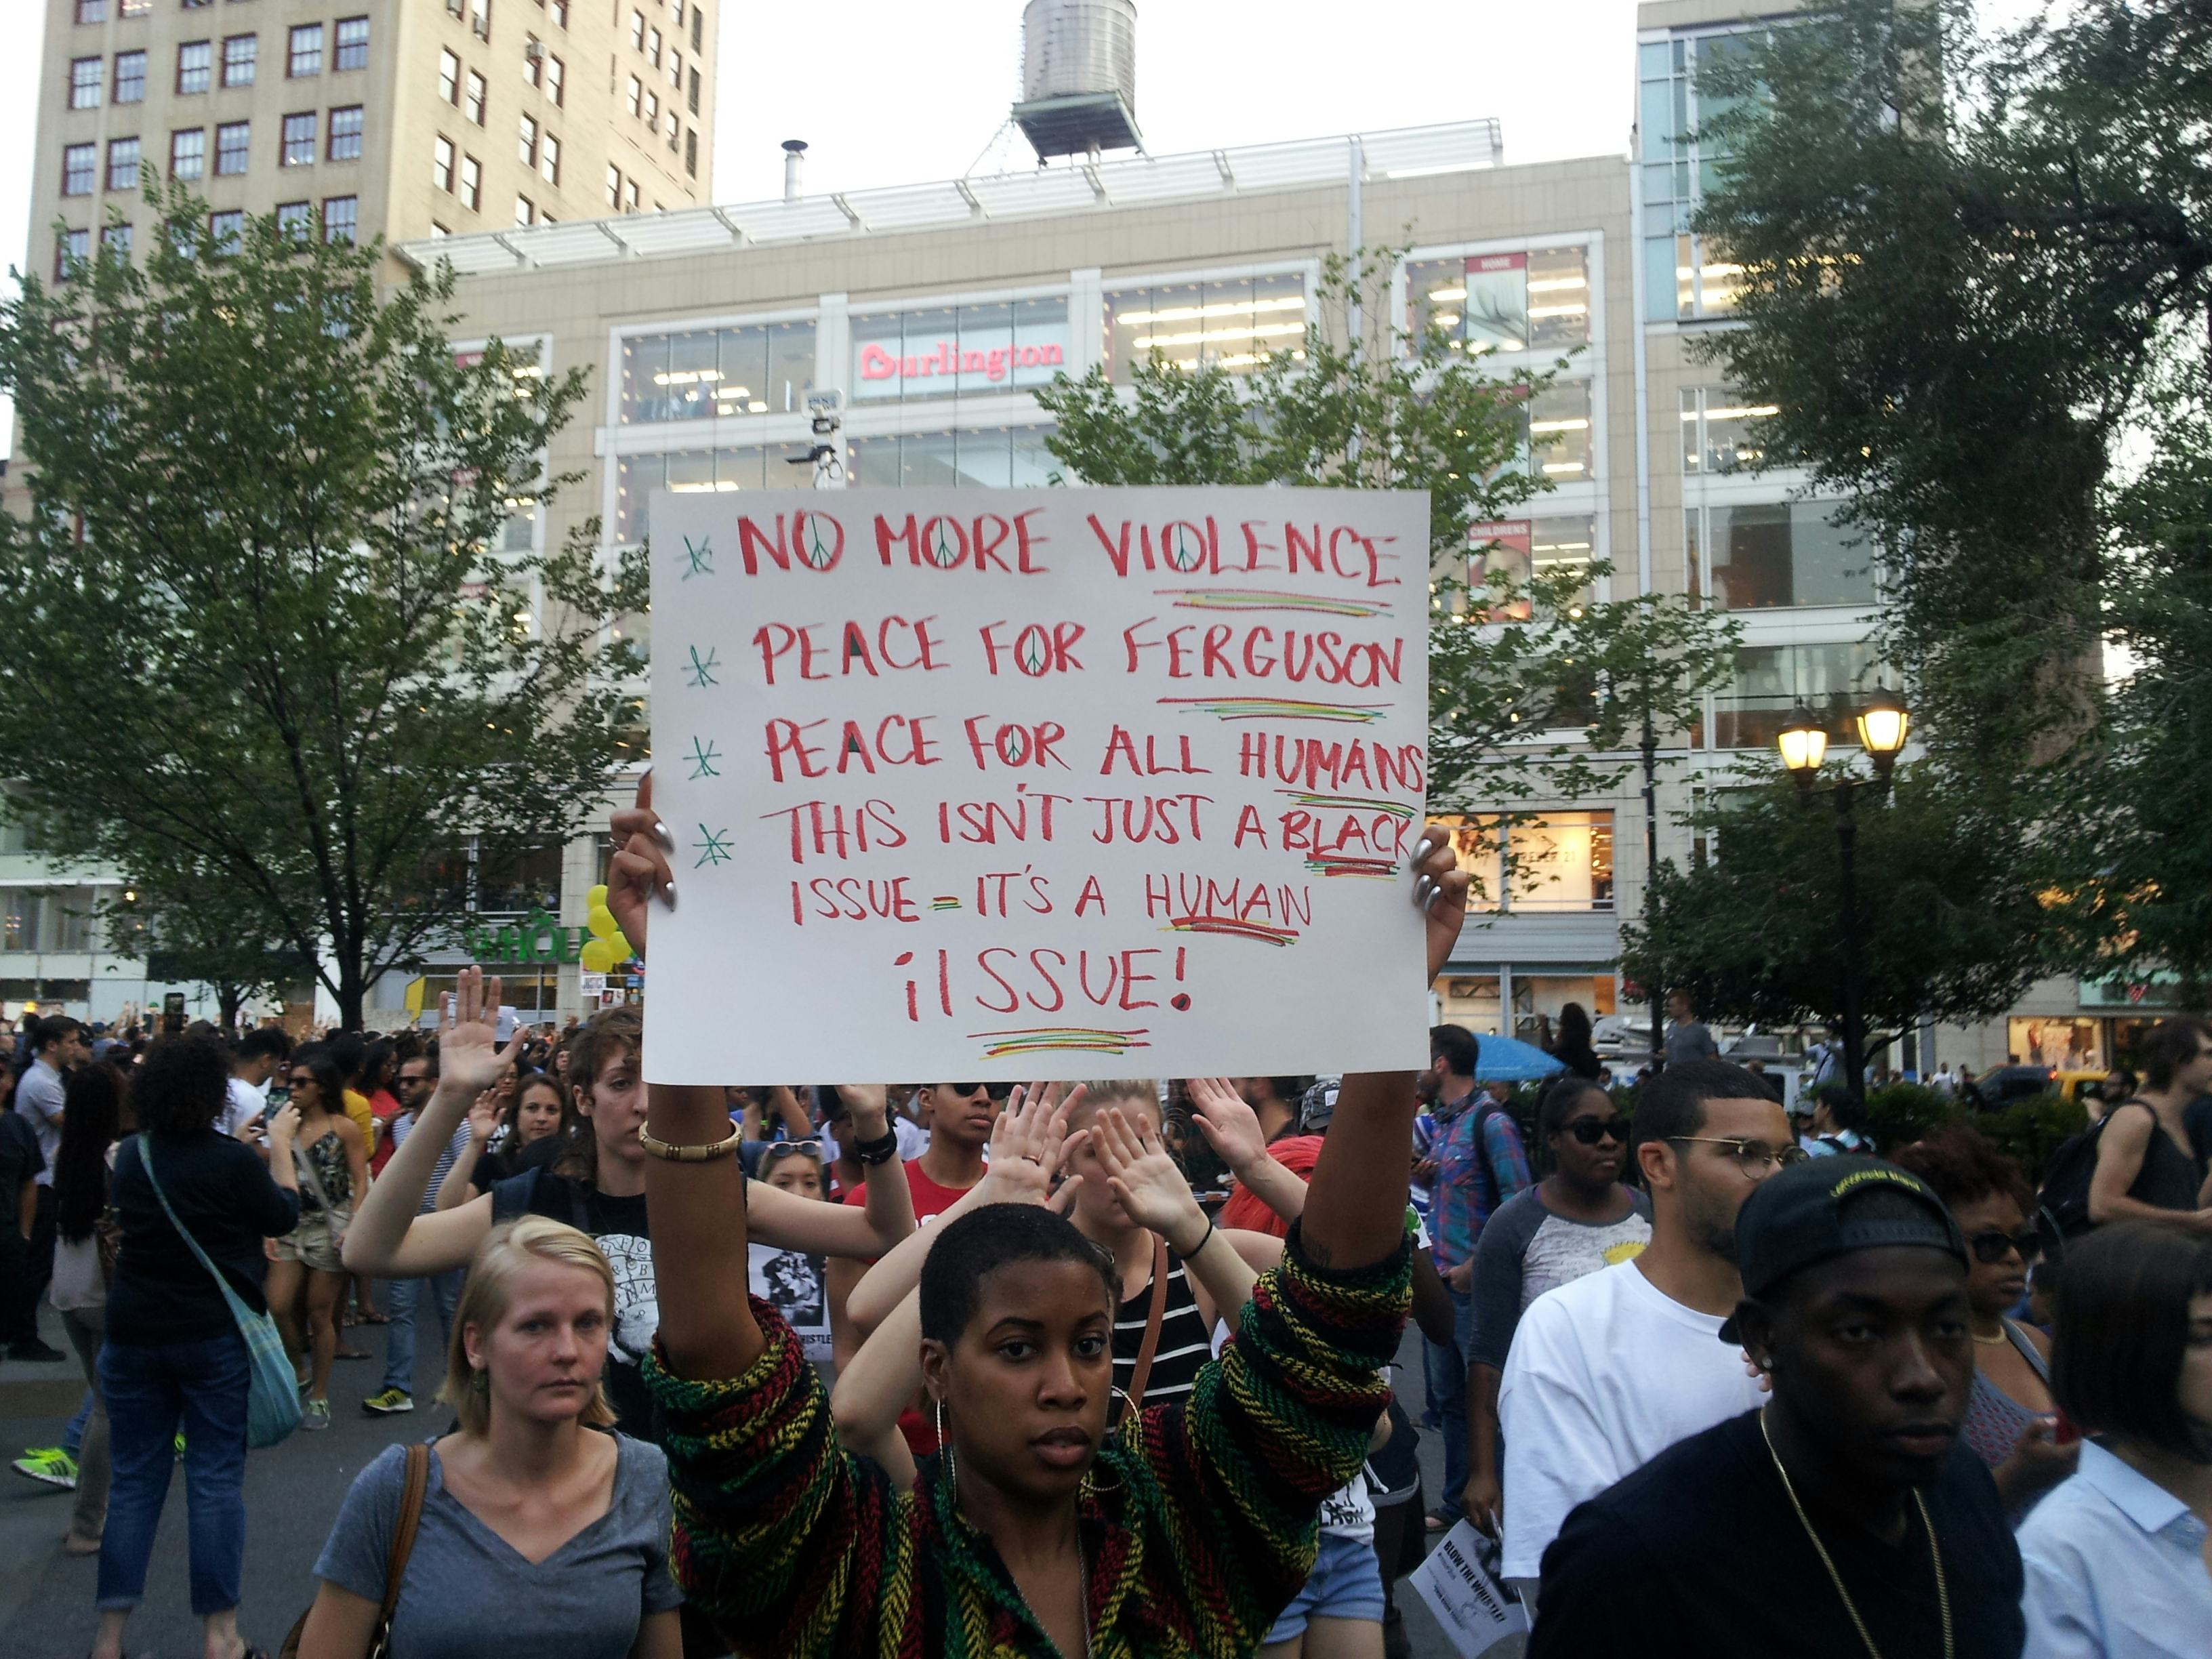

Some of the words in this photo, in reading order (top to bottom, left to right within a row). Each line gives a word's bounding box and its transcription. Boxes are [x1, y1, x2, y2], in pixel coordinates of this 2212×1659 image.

[861, 340, 1064, 382] Burlington
[738, 510, 844, 575] NO
[874, 508, 1051, 575] MORE
[1088, 514, 1399, 588] VIOLENCE
[1470, 523, 1528, 538] CHILDRENS
[752, 615, 950, 685] PEACE
[979, 622, 1084, 678] FOR
[1124, 616, 1404, 689] FERGUSON
[764, 714, 943, 783] PEACE
[964, 716, 1071, 771] FOR
[1101, 725, 1213, 776] ALL
[1240, 733, 1423, 793] HUMANS
[760, 799, 908, 864] THIS
[939, 783, 1072, 844] ISN'T
[1085, 793, 1215, 845] JUST
[1235, 805, 1267, 847] A
[1280, 806, 1410, 855] BLACK
[977, 865, 1052, 917] IT'S
[1075, 878, 1106, 916] A
[1146, 874, 1310, 924] HUMAN
[798, 1334, 832, 1344] HISTLE
[1442, 1540, 1465, 1568] BLOW
[1459, 1564, 1475, 1584] THE
